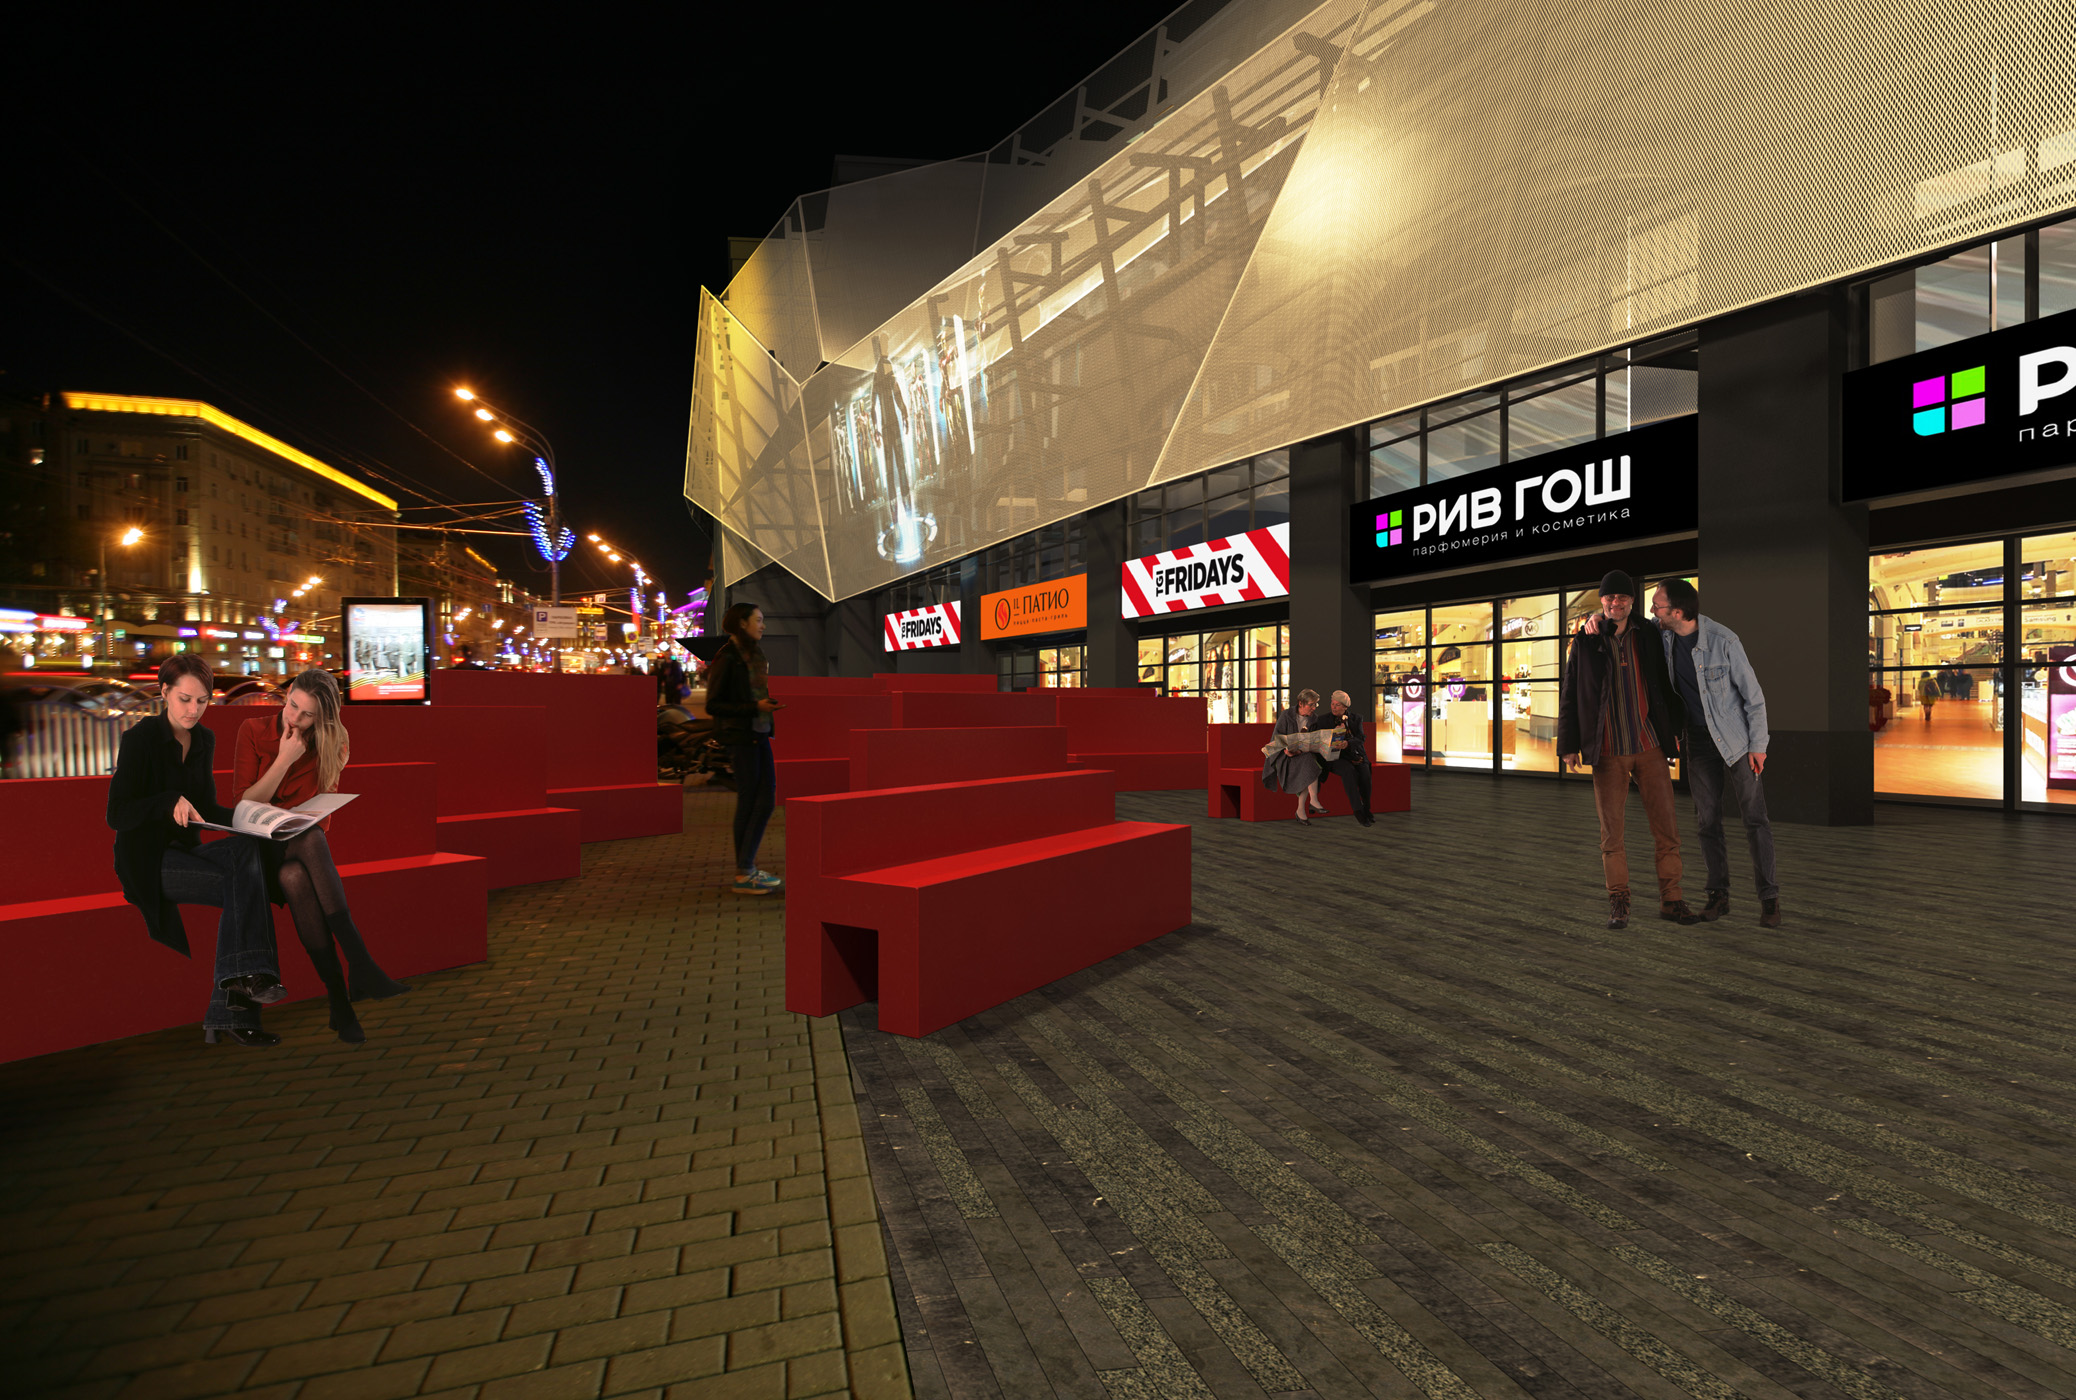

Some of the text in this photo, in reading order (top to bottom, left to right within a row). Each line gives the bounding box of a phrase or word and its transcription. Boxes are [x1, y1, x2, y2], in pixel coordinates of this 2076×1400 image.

[2019, 345, 2076, 416] Р
[1413, 454, 1631, 542] РИВ ГОШ
[1413, 507, 1631, 556] парфюмерия и косметика
[1155, 553, 1244, 597] TGI FRIDAYS
[1013, 588, 1069, 615] IL ПАТИО
[905, 616, 942, 639] FRIDAYS
